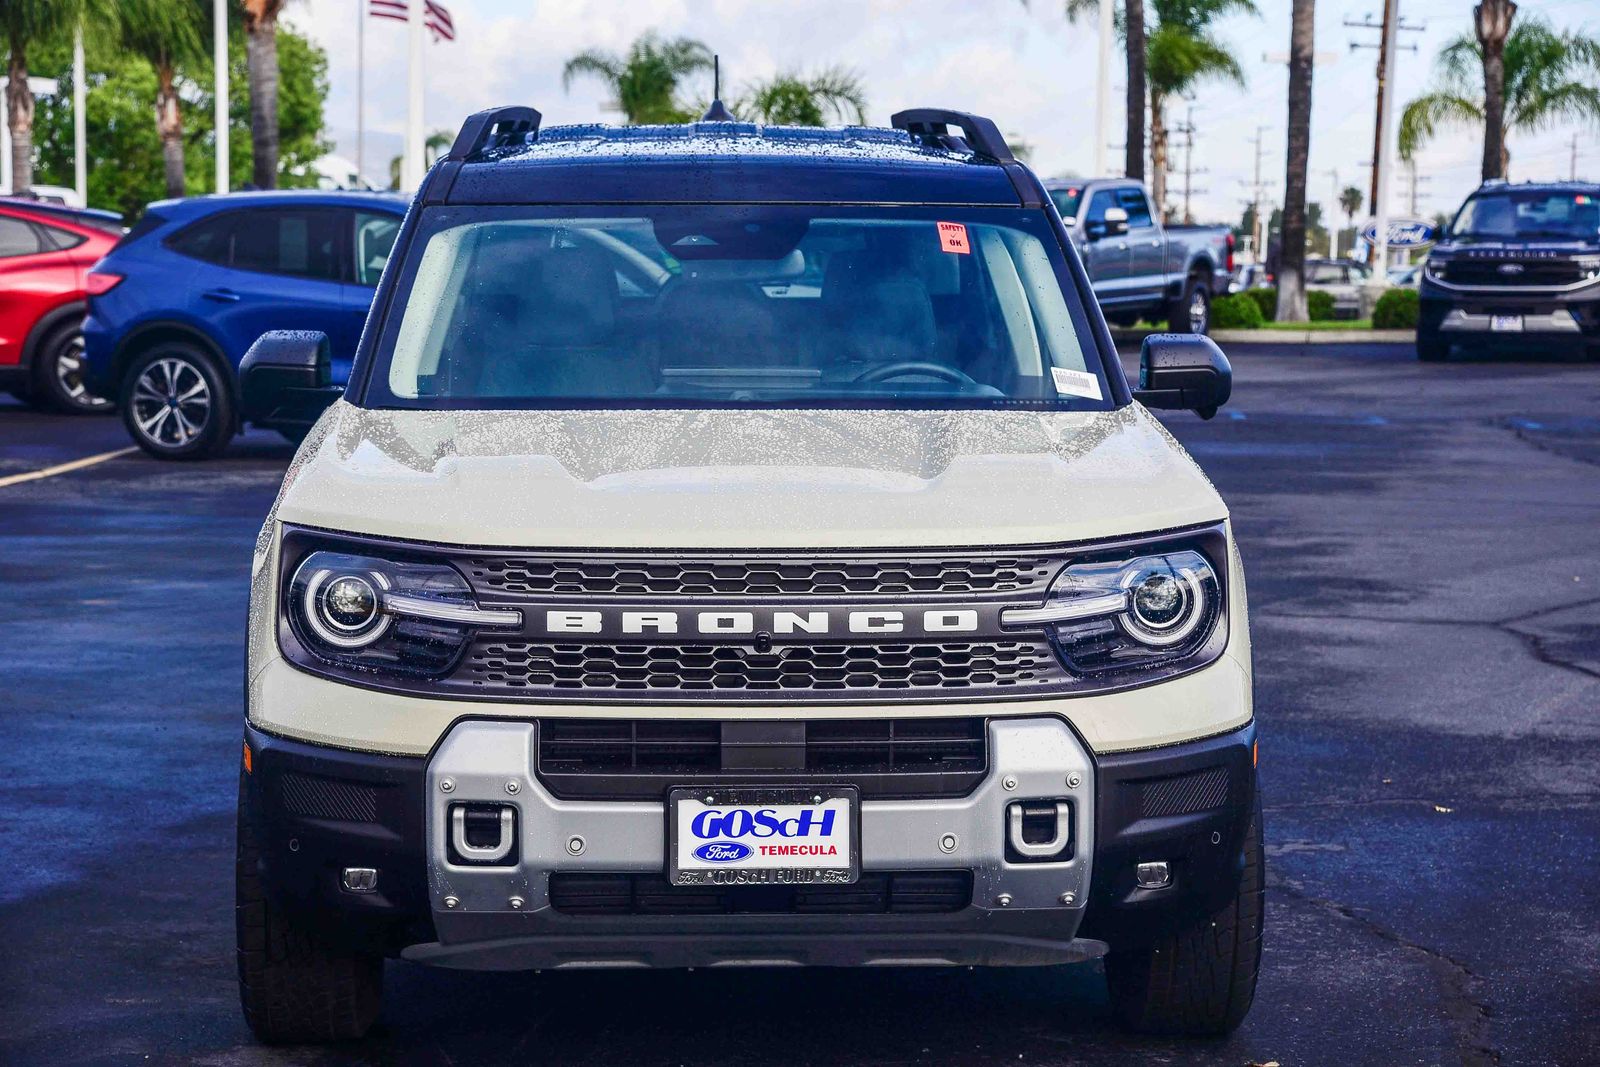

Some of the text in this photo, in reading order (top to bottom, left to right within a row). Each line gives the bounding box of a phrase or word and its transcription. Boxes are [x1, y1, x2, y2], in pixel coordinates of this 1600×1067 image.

[940, 224, 964, 232] SAFETY
[949, 239, 962, 247] OK
[546, 610, 978, 633] BRONCO
[705, 844, 740, 860] Ford
[759, 845, 838, 856] TEMECULA
[677, 871, 706, 884] Ford
[774, 868, 814, 884] FORD
[821, 870, 852, 884] Ford
